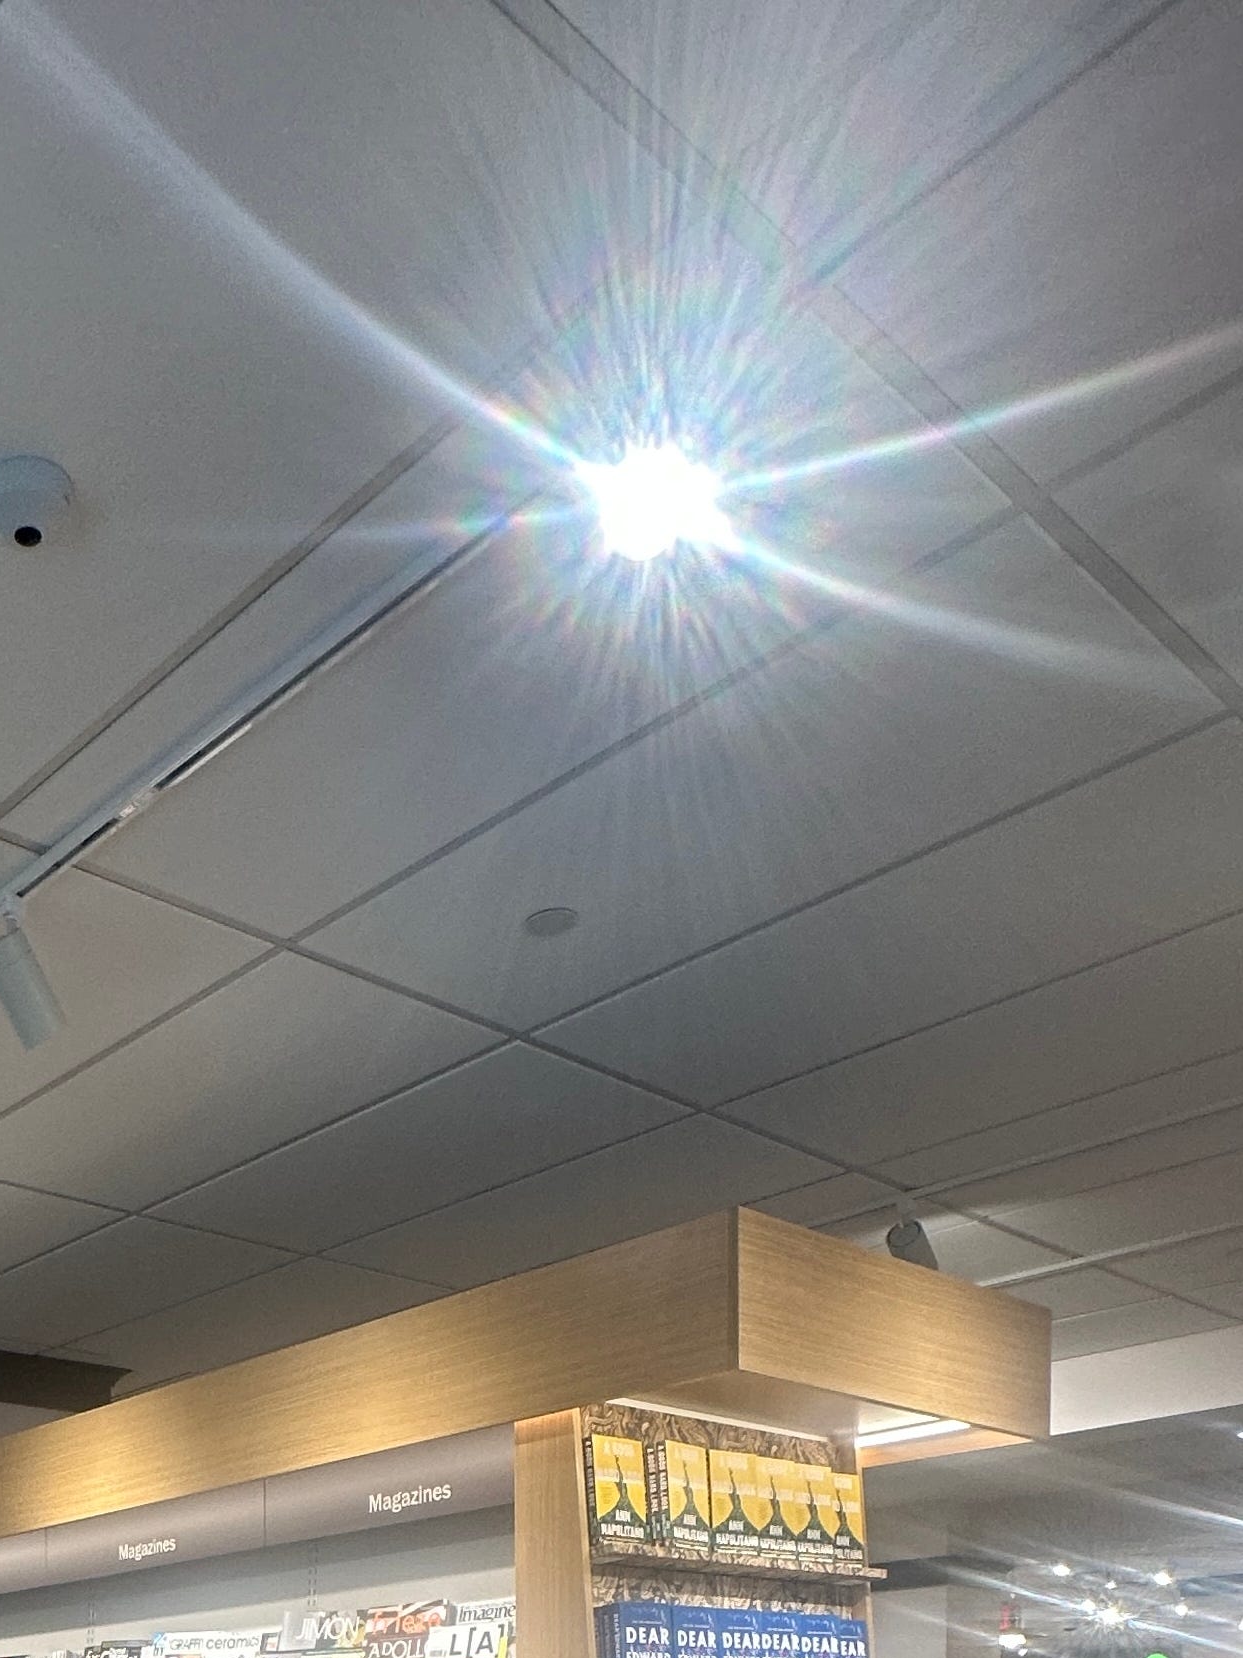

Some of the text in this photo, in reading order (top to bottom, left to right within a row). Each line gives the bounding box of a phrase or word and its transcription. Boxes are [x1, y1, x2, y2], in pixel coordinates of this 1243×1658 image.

[368, 1484, 452, 1514] Magazines
[118, 1536, 176, 1561] Magazines
[625, 1627, 670, 1645] DEAR
[678, 1629, 717, 1648] DEAR
[722, 1632, 762, 1650] DEAR
[762, 1633, 801, 1651] DEAR
